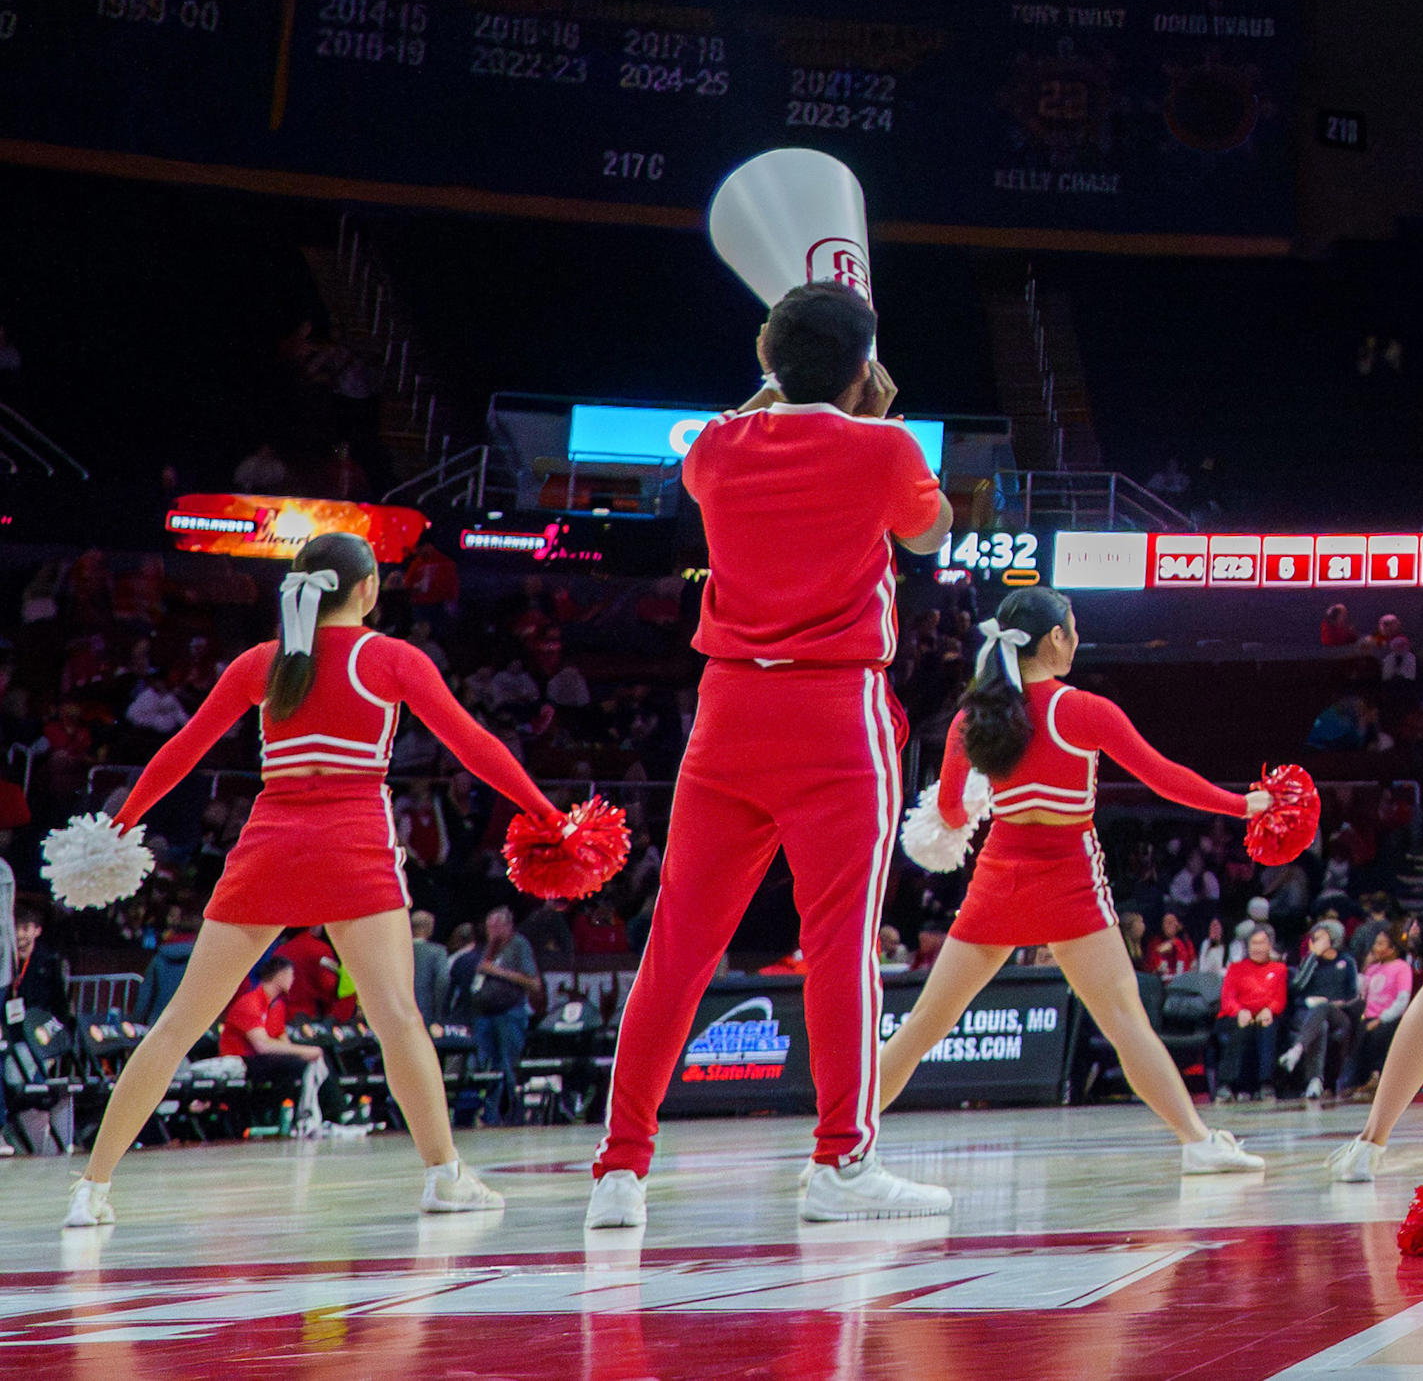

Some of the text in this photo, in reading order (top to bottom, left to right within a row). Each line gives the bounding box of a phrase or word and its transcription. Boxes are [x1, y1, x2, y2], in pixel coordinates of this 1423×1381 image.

[470, 46, 589, 83] 2022-23
[619, 63, 729, 96] 2024-25
[790, 68, 896, 102] 2021-22
[786, 100, 895, 132] 2023-24
[603, 149, 666, 181] 217C
[938, 532, 1038, 568] 14:32
[1329, 556, 1352, 579] 21
[1387, 556, 1399, 579] 1
[1027, 1007, 1058, 1032] MO
